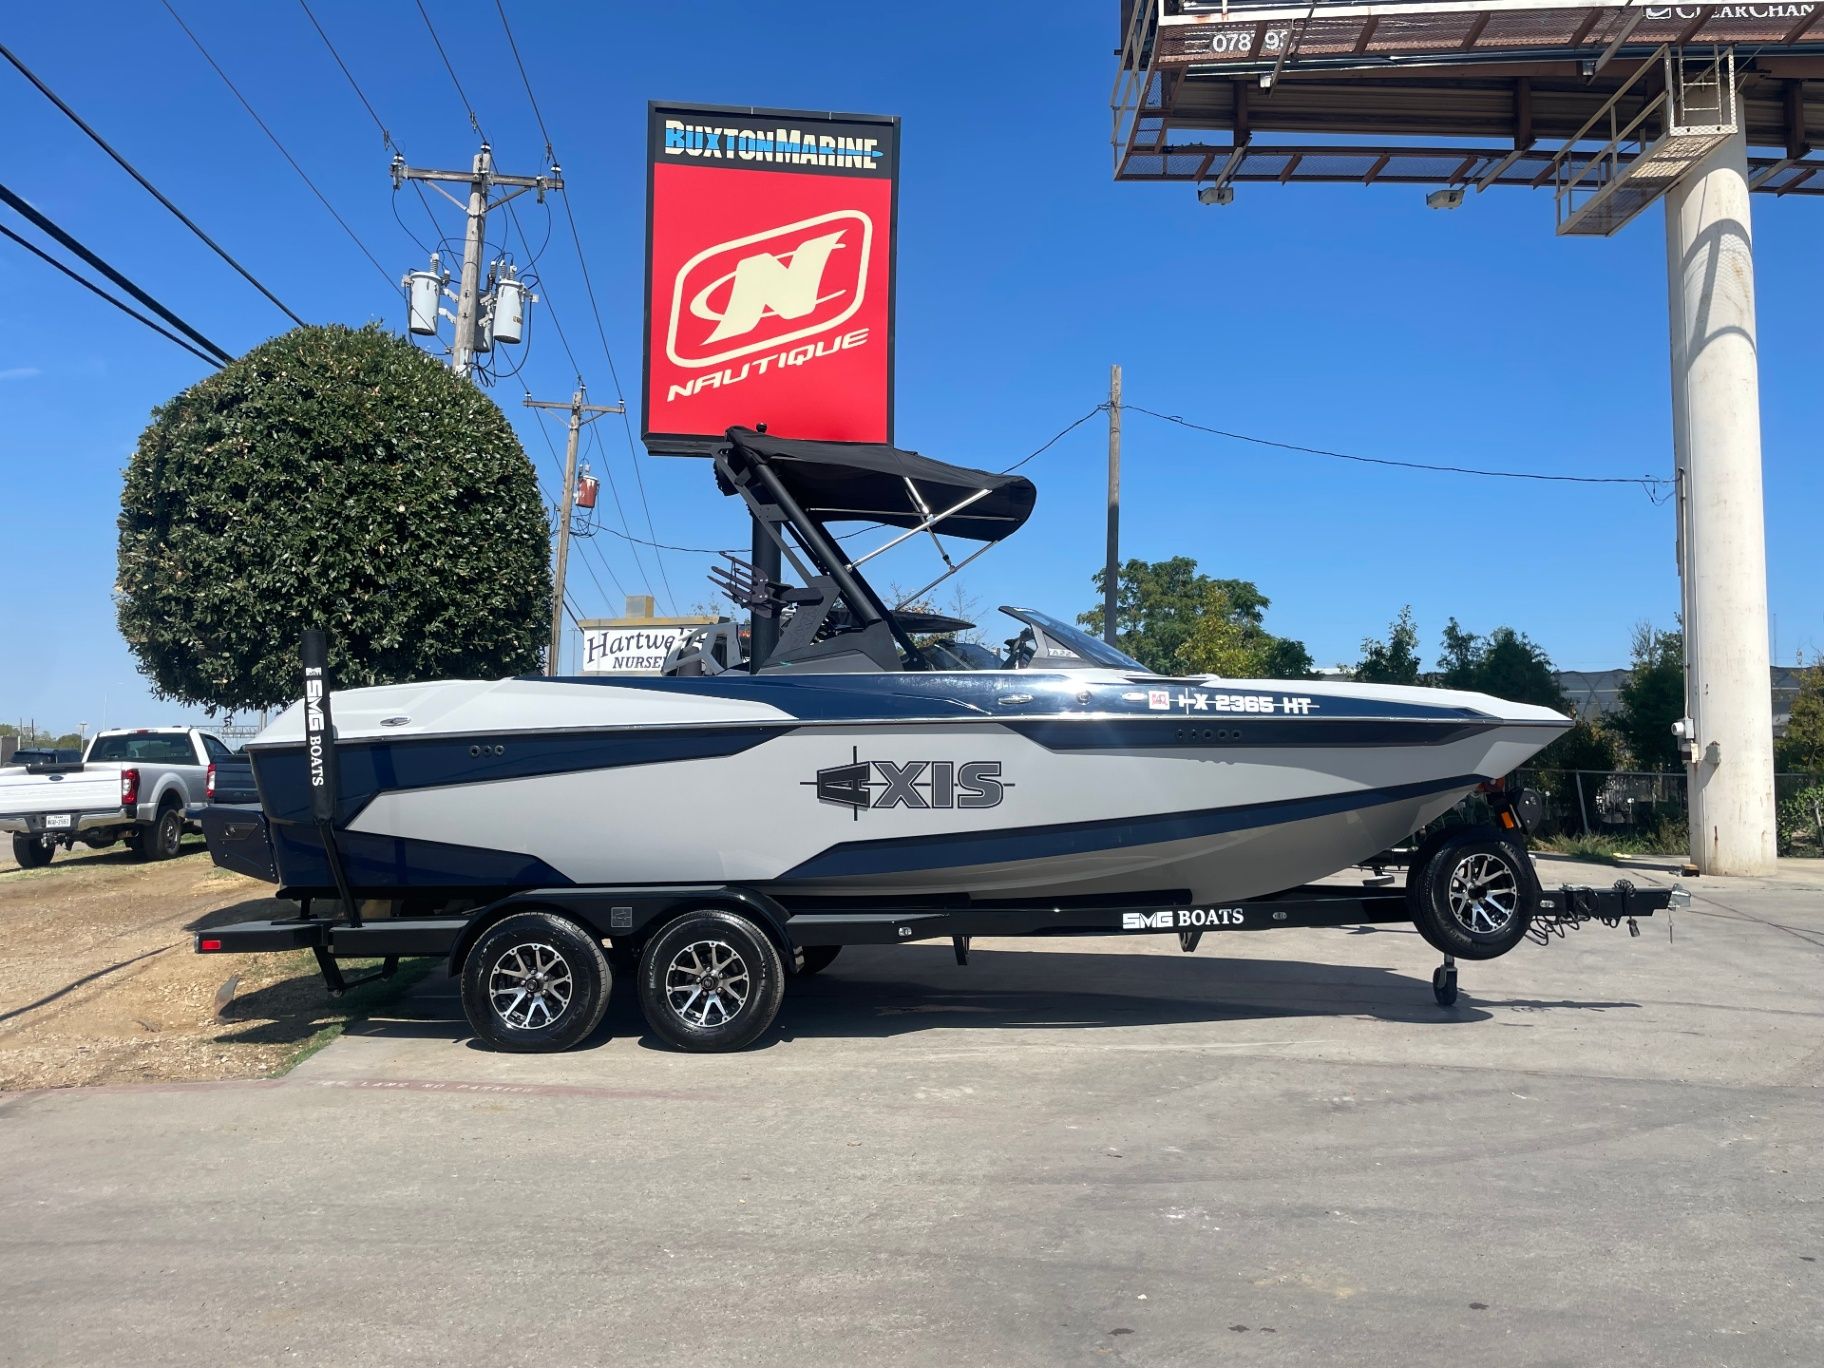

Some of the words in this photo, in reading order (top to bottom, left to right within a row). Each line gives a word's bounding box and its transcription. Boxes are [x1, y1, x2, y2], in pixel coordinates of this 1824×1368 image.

[666, 327, 870, 402] NAUTIQUE
[612, 655, 668, 670] NURSE
[306, 680, 325, 731] SMG
[1215, 694, 1274, 713] 2365
[1282, 696, 1312, 715] HT
[310, 735, 325, 787] BOATS
[815, 759, 1005, 812] AXIS
[1122, 910, 1174, 930] SMG
[1177, 907, 1245, 927] BOATS
